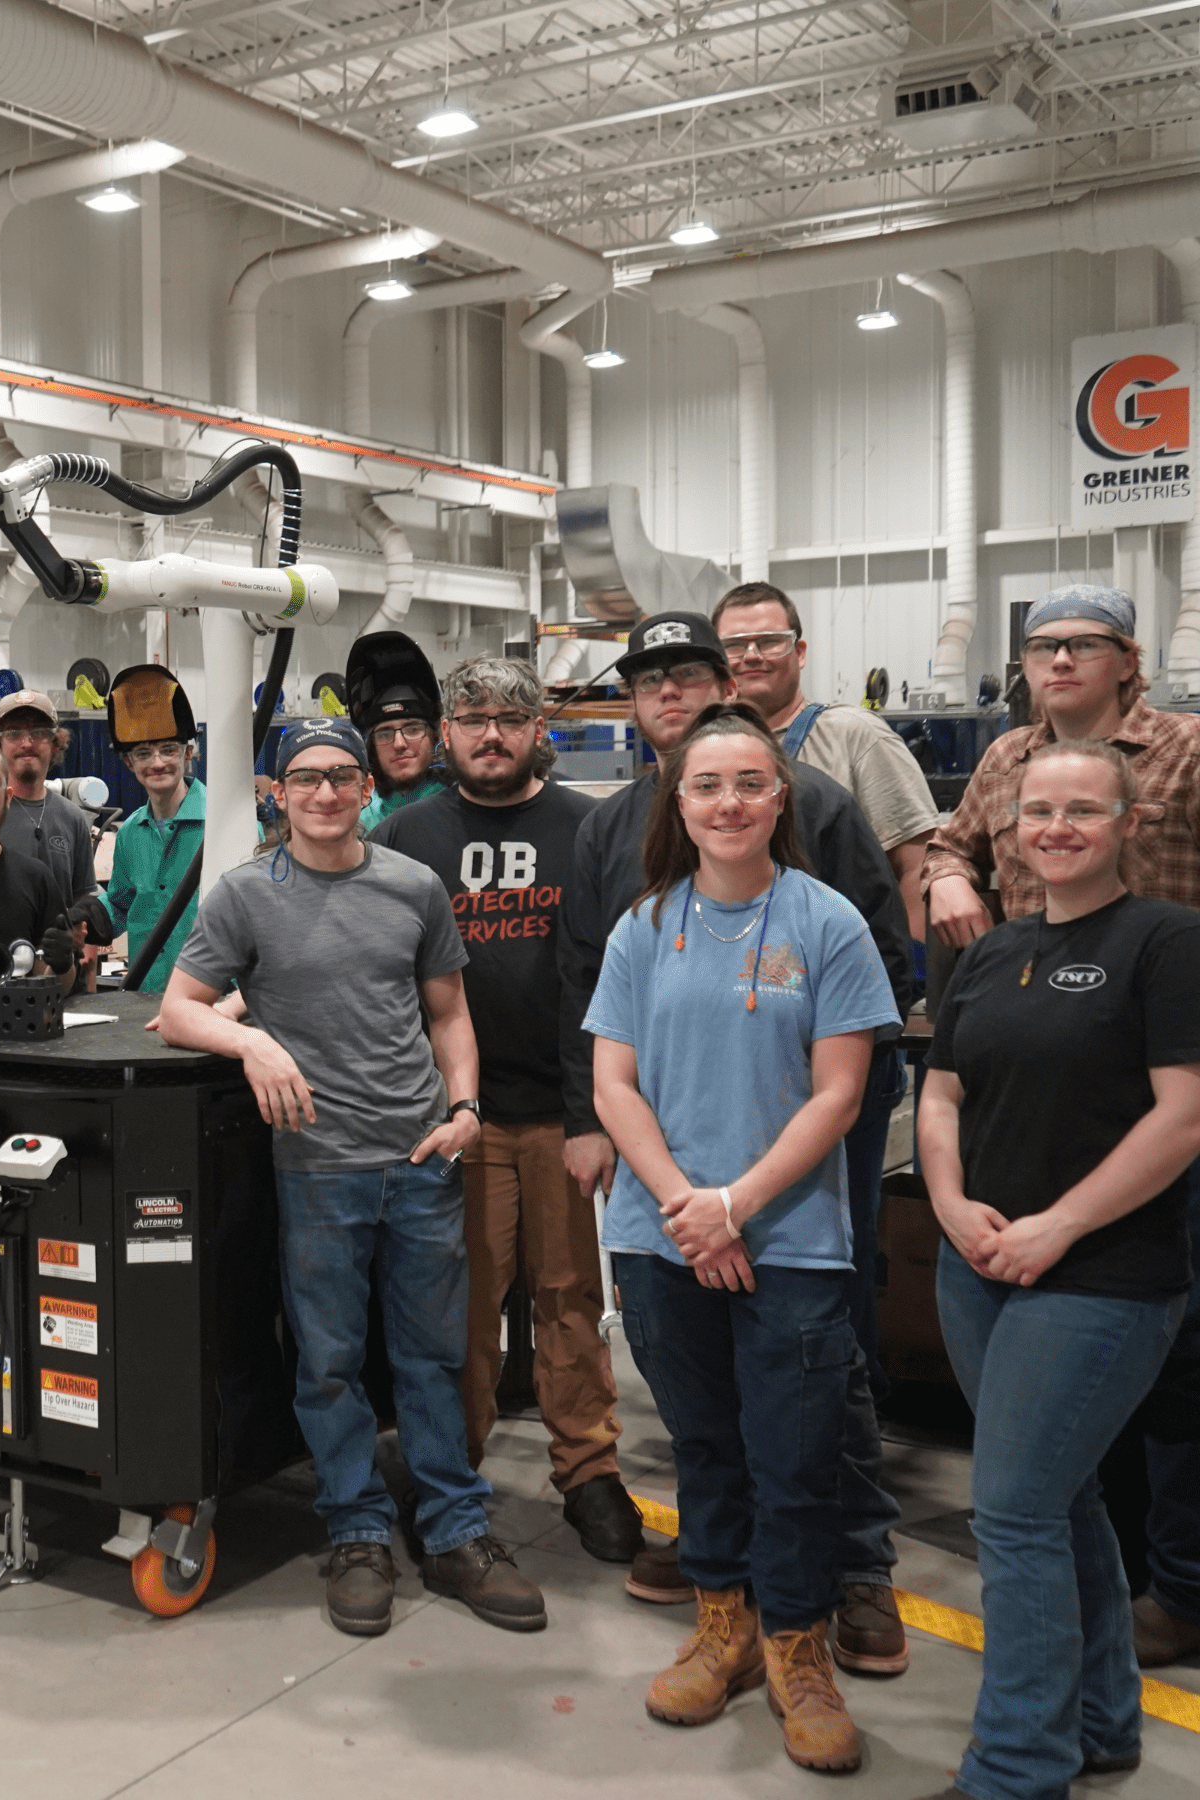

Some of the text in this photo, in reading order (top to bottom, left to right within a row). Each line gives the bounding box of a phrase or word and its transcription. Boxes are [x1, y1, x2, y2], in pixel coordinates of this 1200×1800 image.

[1084, 464, 1190, 489] GREINER
[1084, 483, 1191, 506] INDUSTRIES
[295, 729, 343, 743] Wilson Products
[450, 886, 562, 915] OTECTIO
[456, 915, 551, 943] ERVICES
[138, 1198, 174, 1207] LINCOLN
[146, 1206, 179, 1214] ELECTRIC
[52, 1302, 95, 1320] WARNING
[54, 1375, 96, 1398] WARNING
[44, 1392, 95, 1412] Tip Over Hazard
